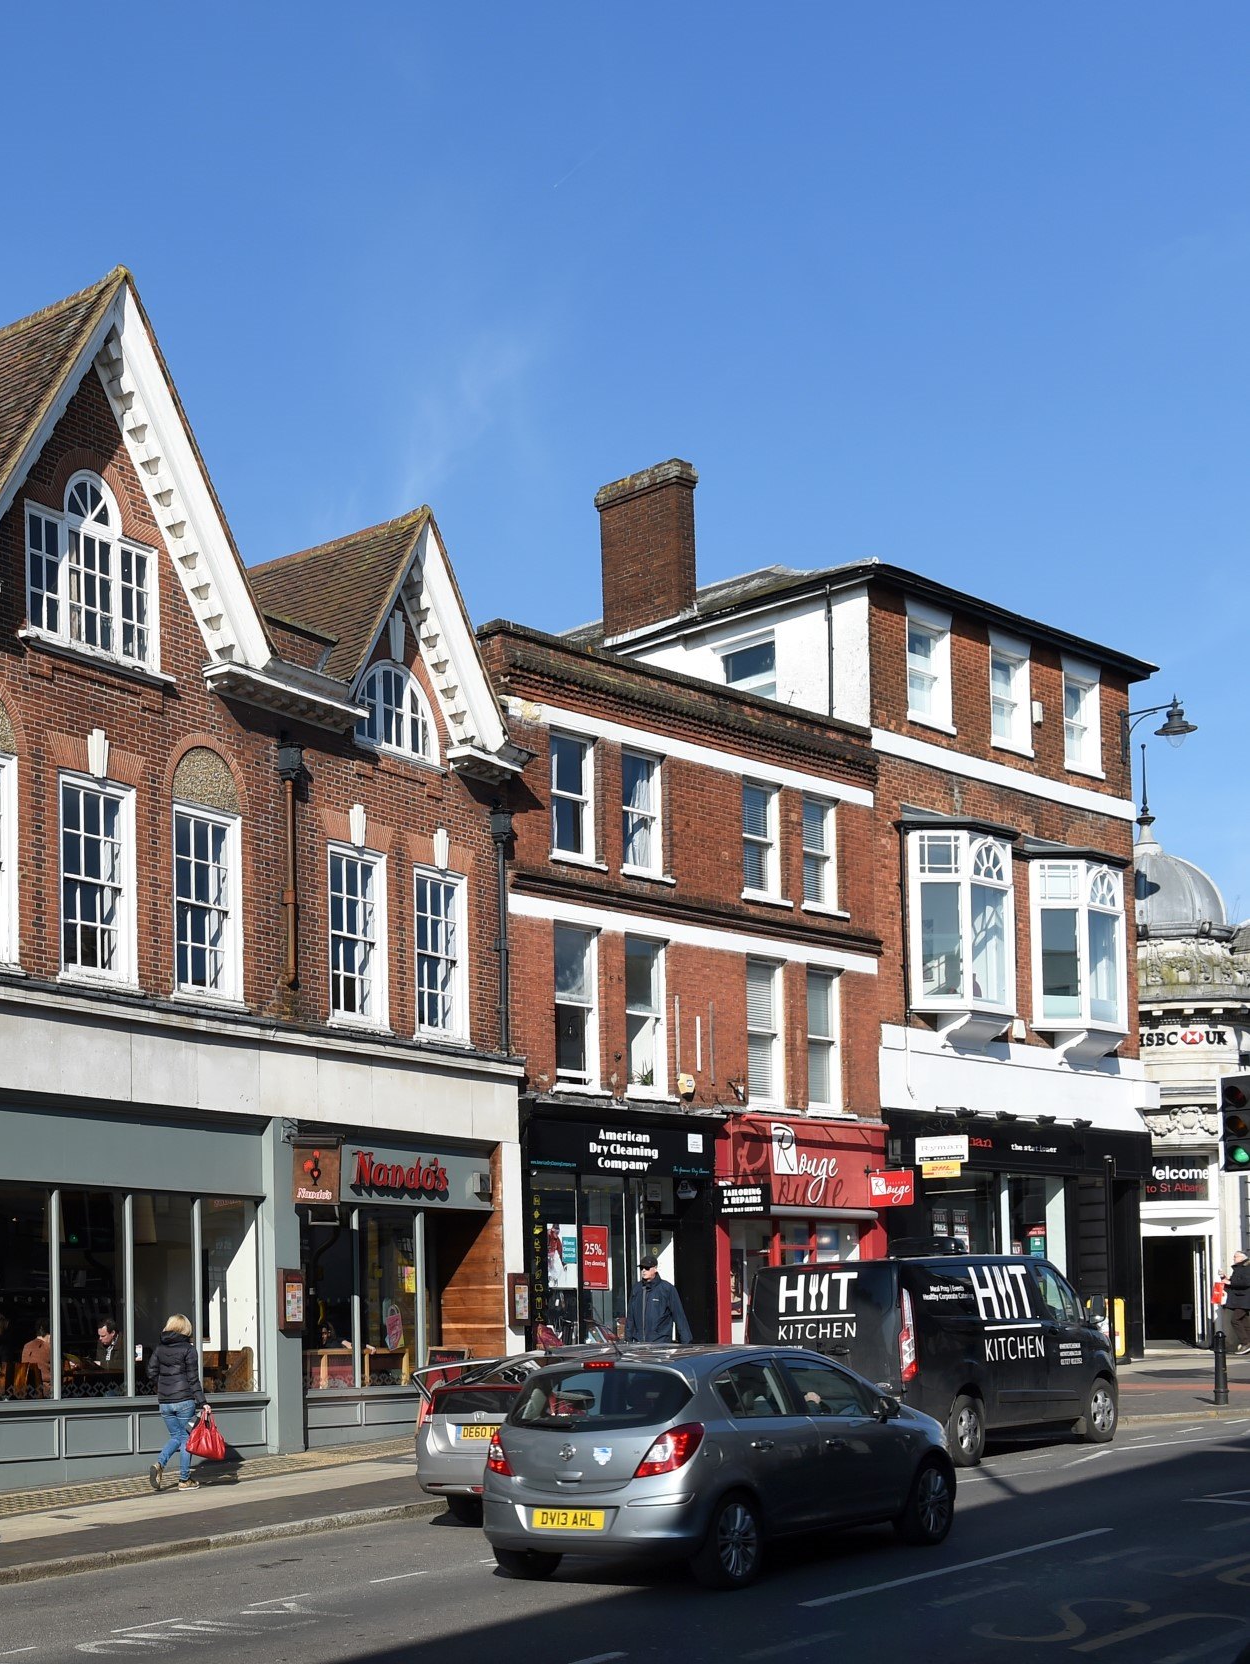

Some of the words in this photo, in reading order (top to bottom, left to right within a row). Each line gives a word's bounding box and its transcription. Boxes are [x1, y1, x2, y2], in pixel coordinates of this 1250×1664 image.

[1205, 1031, 1227, 1045] UK
[599, 1129, 650, 1143] American
[589, 1142, 609, 1156] Dry
[610, 1144, 659, 1159] Cleaning
[921, 1144, 963, 1153] Ryman
[1011, 1143, 1023, 1151] the
[1024, 1144, 1057, 1154] stationer
[353, 1151, 449, 1191] Nando's
[597, 1157, 650, 1172] Company
[772, 1124, 839, 1204] Rouge
[297, 1188, 332, 1200] Nando's
[722, 1188, 762, 1197] TAILORING
[872, 1178, 912, 1204] Rouge
[1146, 1184, 1157, 1193] to
[1159, 1183, 1171, 1193] St
[730, 1196, 762, 1204] REPAIRS
[584, 1243, 602, 1256] 25%
[777, 1321, 857, 1341] KITCHEN
[984, 1335, 1045, 1362] KITCHEN
[463, 1427, 486, 1438] DE60
[541, 1512, 568, 1526] DV13
[571, 1513, 595, 1526] AHL
